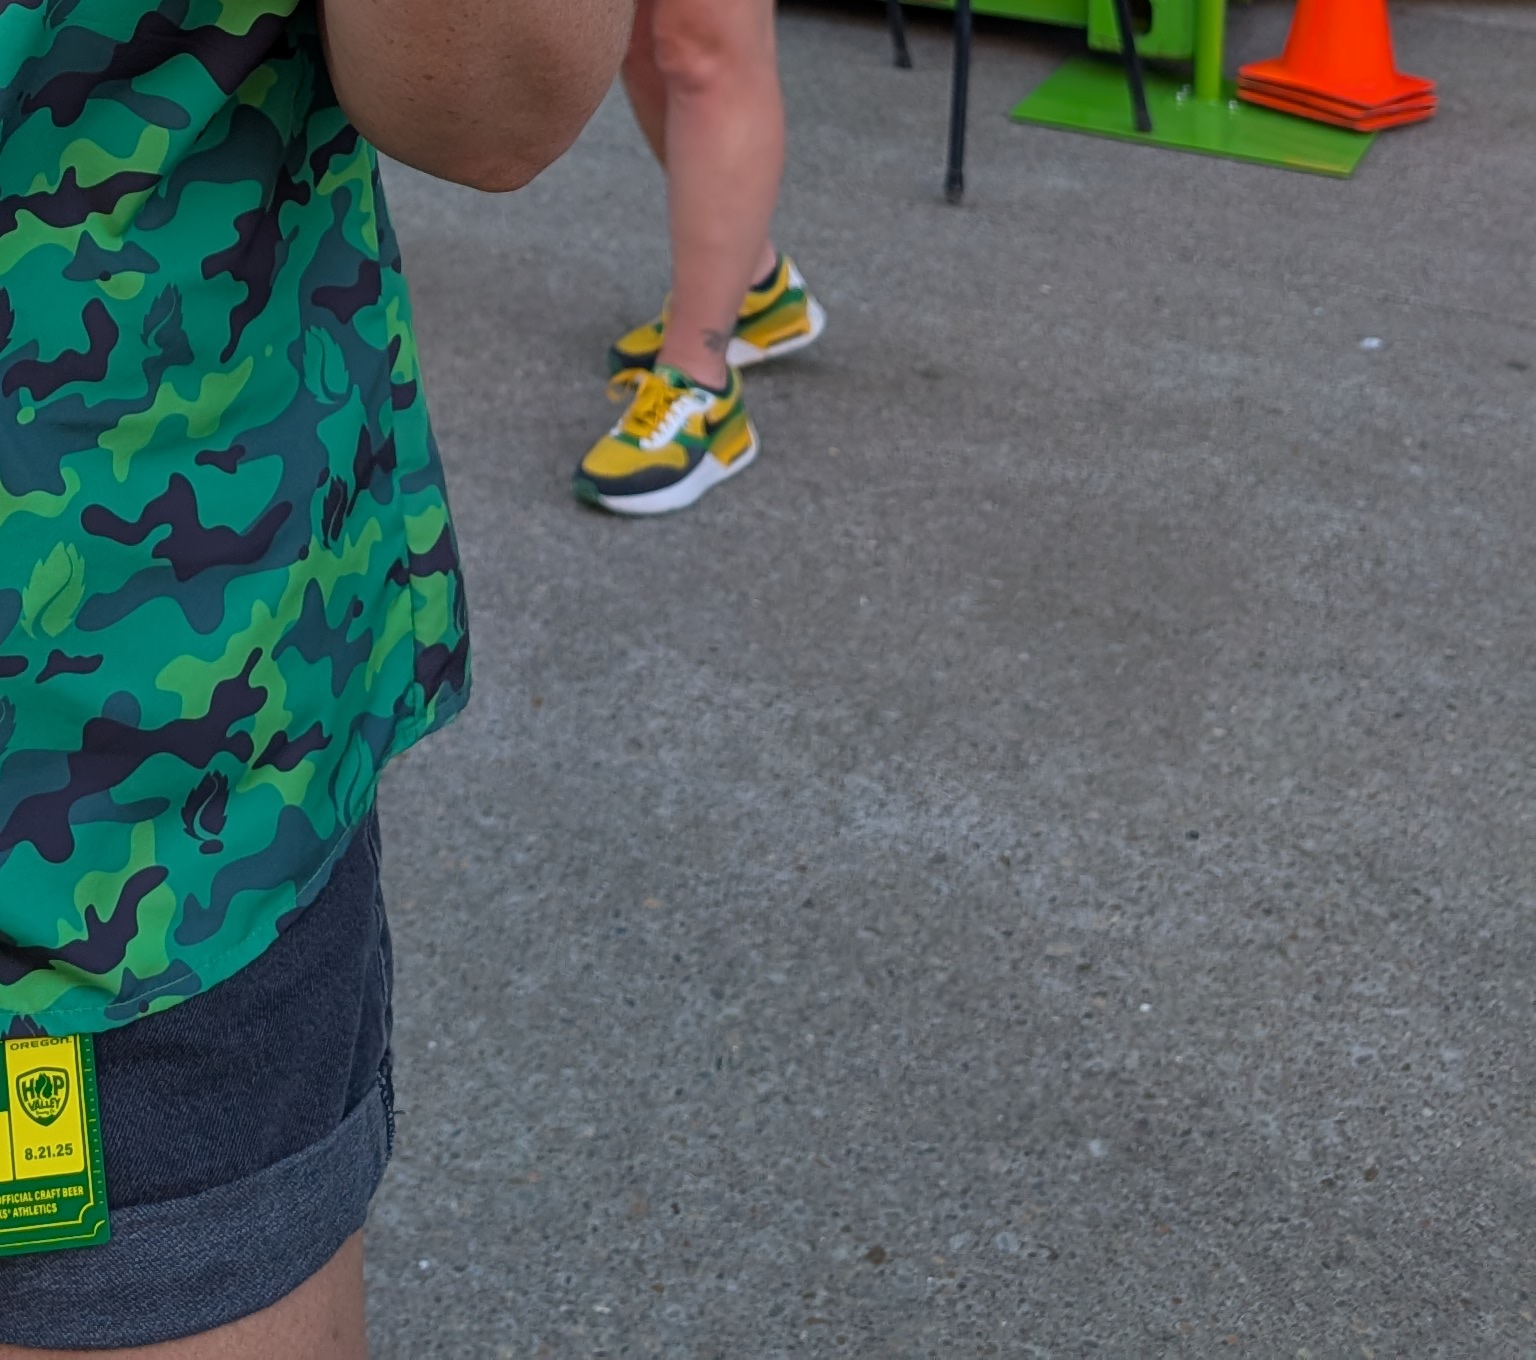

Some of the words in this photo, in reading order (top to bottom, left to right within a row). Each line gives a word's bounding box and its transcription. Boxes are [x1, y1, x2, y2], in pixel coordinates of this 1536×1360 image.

[21, 1072, 65, 1102] HOP
[28, 1097, 61, 1112] VALLEY
[24, 1143, 74, 1161] 8.21.25
[34, 1188, 61, 1201] CRAFT
[63, 1186, 84, 1197] BEER
[13, 1203, 58, 1218] ATHLETICS
